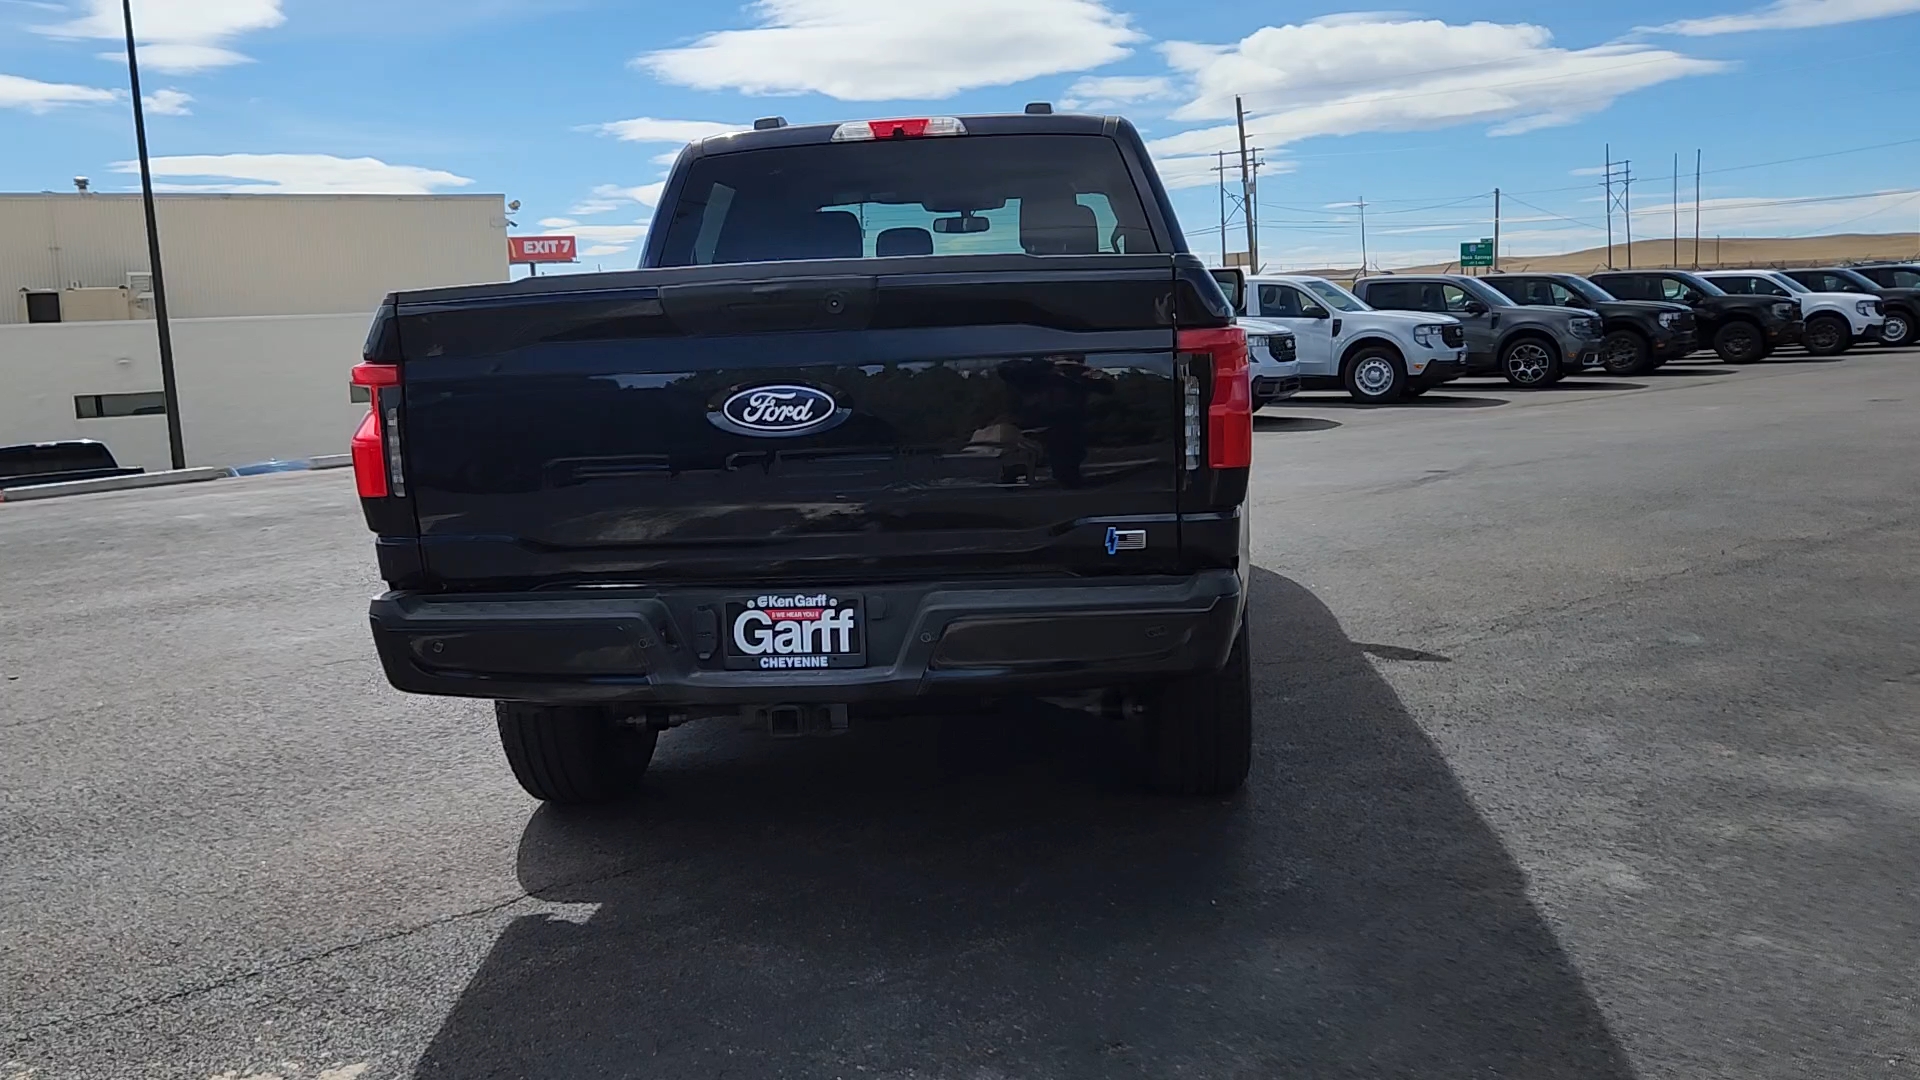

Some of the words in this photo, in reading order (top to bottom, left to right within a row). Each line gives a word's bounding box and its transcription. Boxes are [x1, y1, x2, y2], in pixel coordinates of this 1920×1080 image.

[523, 240, 558, 254] EXIT
[560, 240, 571, 253] 7
[743, 391, 815, 422] Ford
[769, 595, 795, 608] Ken
[795, 594, 827, 607] Garff
[734, 609, 854, 654] Garff
[760, 656, 828, 668] CHEYENNE
